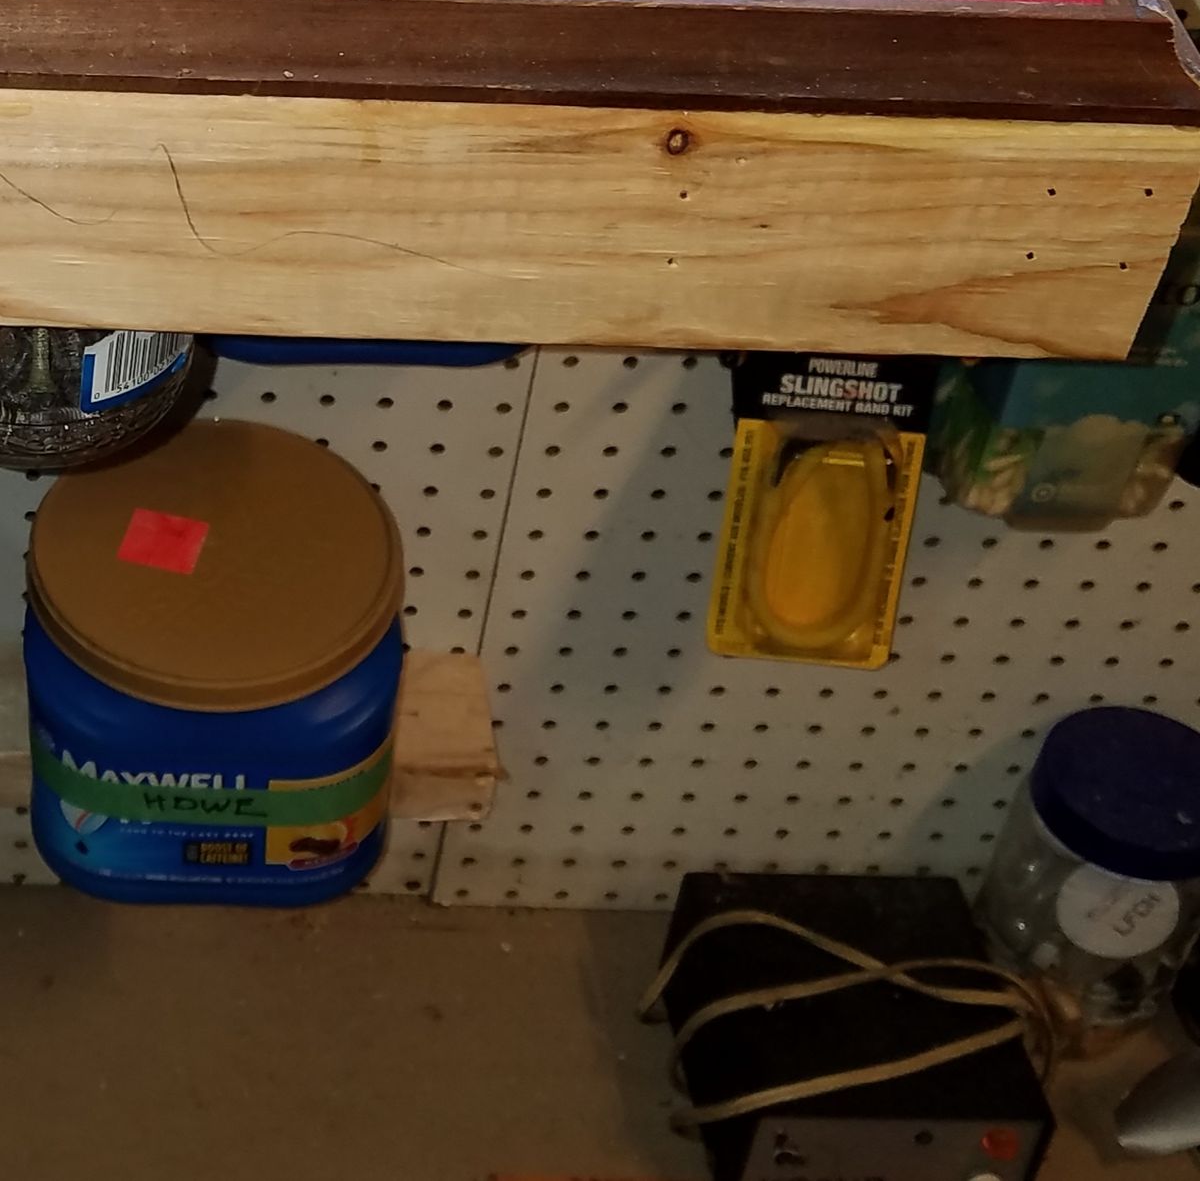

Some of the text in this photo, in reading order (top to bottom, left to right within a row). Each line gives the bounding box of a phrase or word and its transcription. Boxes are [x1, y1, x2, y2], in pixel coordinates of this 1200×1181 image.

[808, 357, 879, 379] POWERLINE
[779, 372, 904, 404] SLINGSHOT
[761, 391, 914, 418] REPLACEMENT BAND KIT
